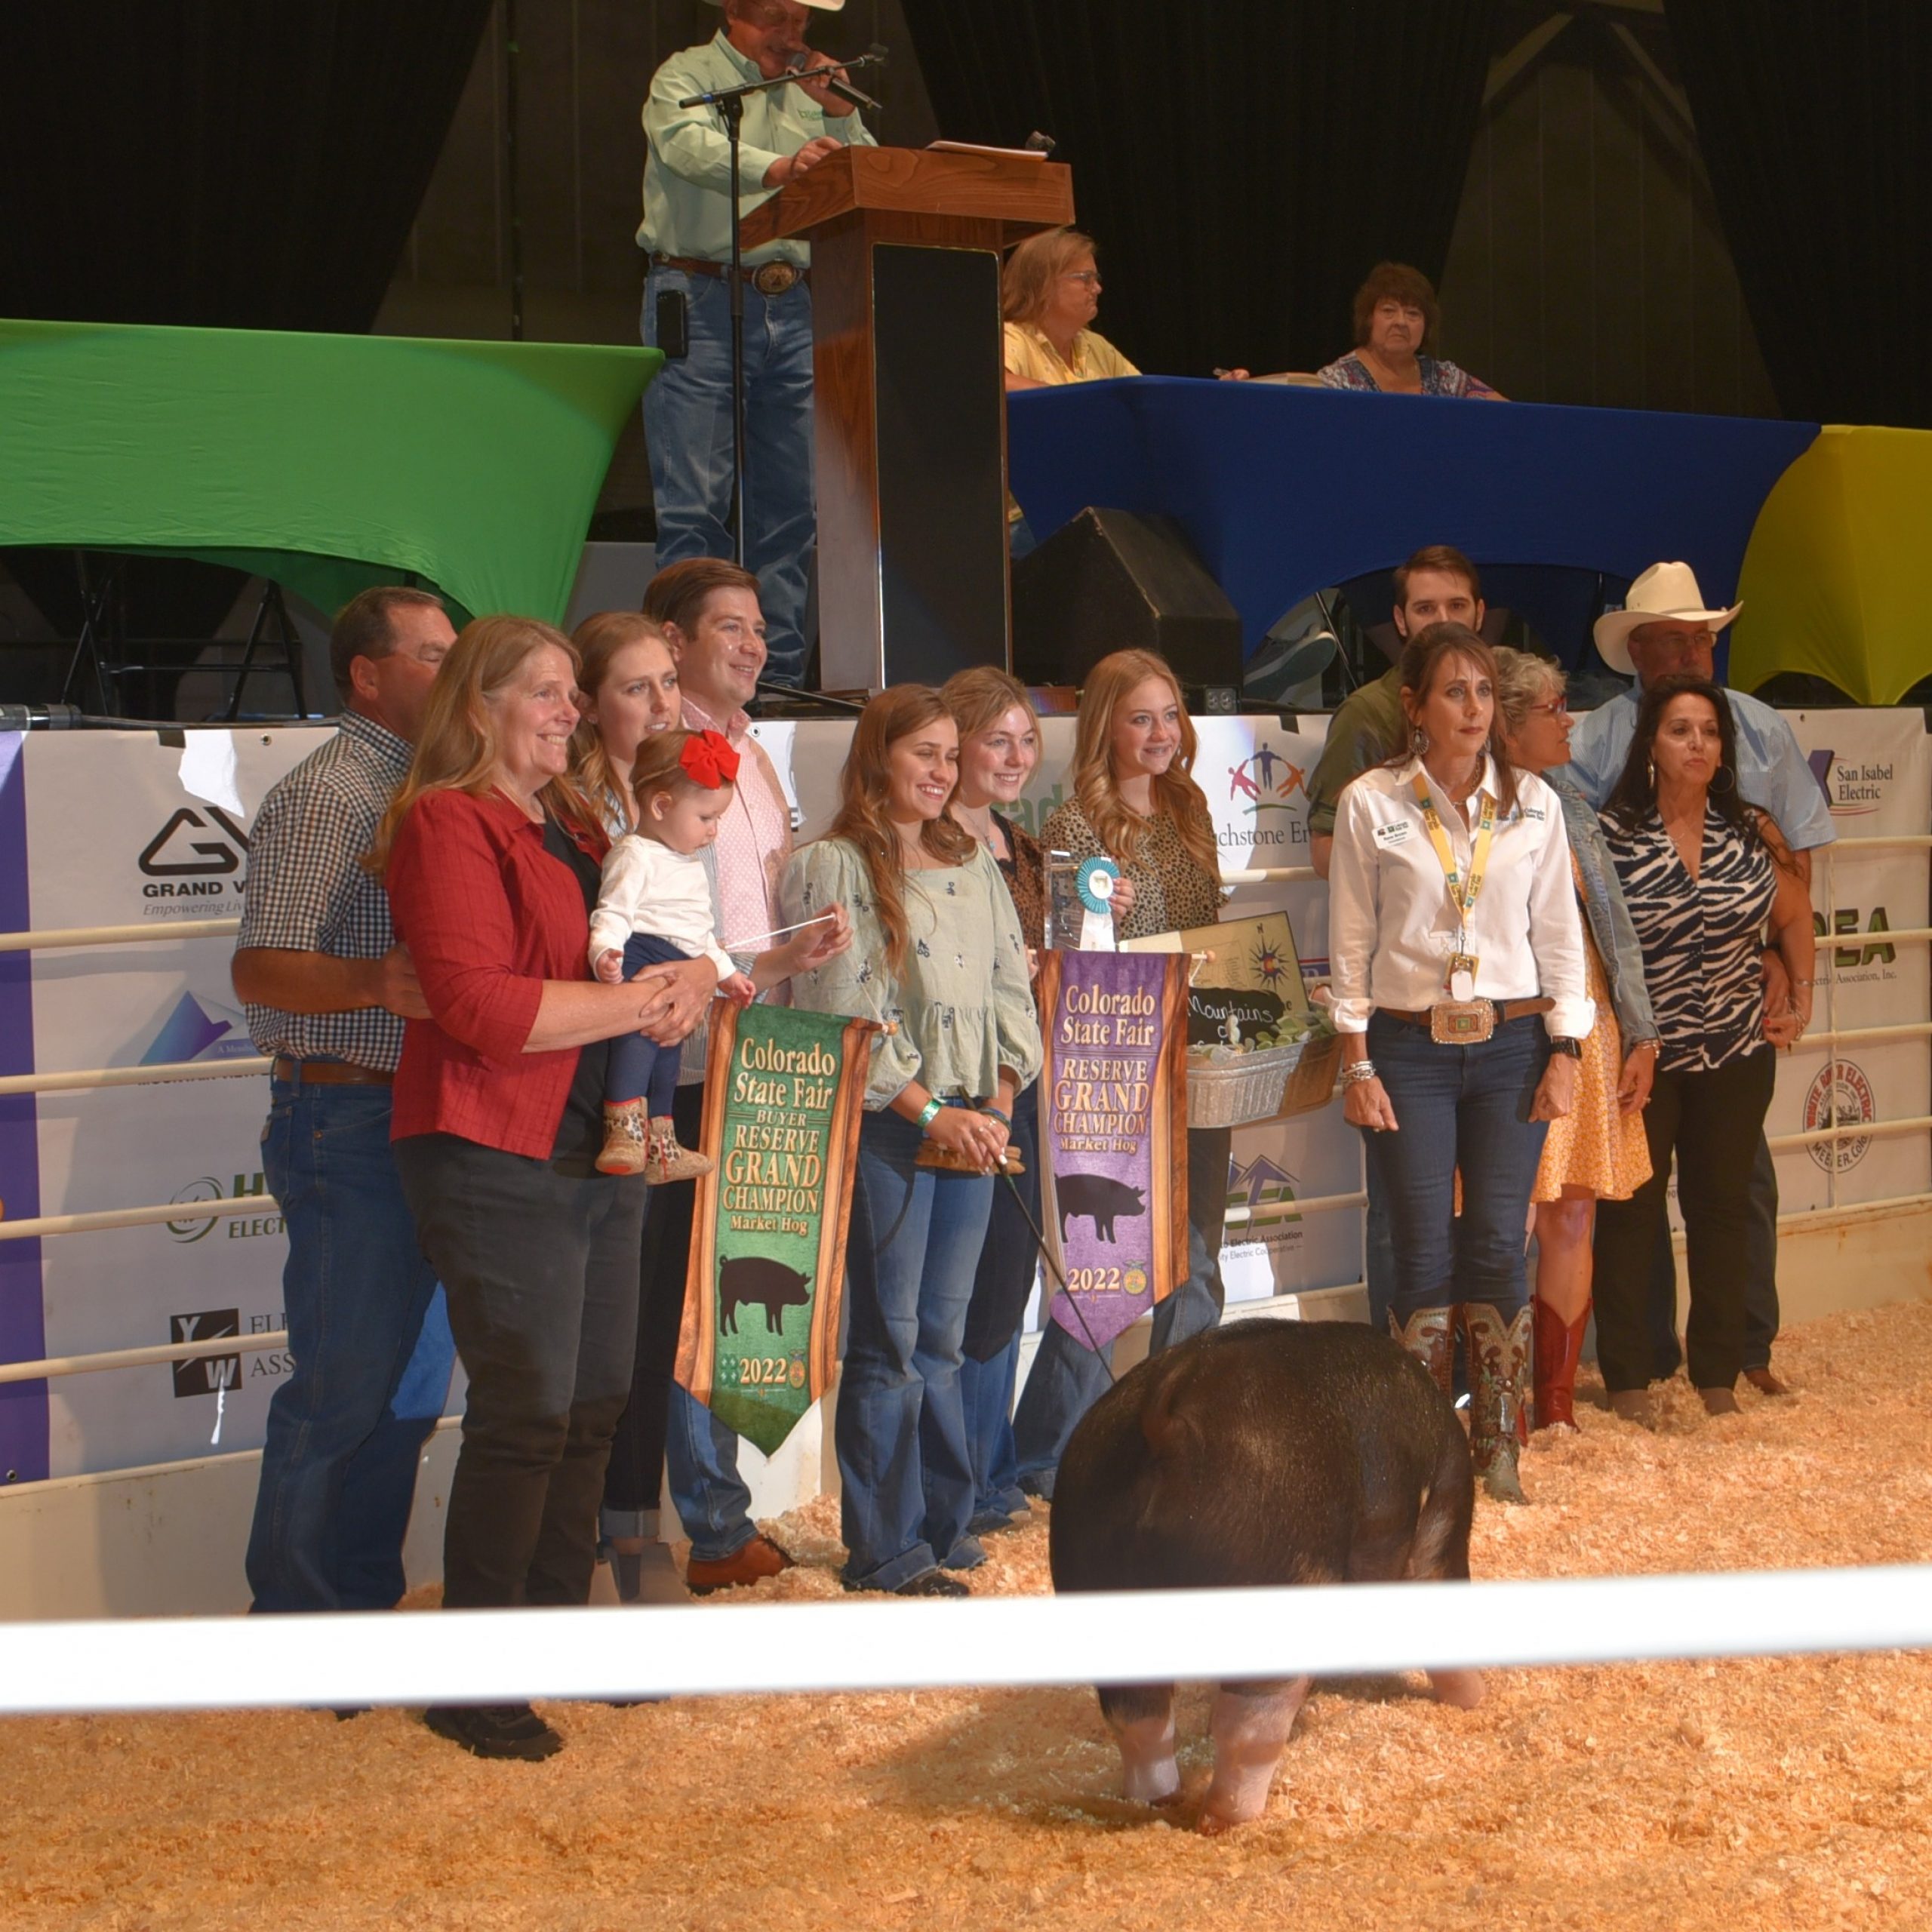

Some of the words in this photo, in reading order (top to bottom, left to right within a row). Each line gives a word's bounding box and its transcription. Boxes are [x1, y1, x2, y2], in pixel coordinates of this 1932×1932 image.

[1837, 765, 1858, 782] San
[1861, 764, 1893, 781] Isabel
[1839, 783, 1881, 801] Electric
[1216, 822, 1286, 846] chstone
[142, 881, 224, 898] GRAND
[143, 900, 224, 918] Empowering
[1066, 984, 1155, 1016] Colorado
[1060, 1016, 1111, 1045] State
[1114, 1017, 1155, 1046] Fair
[740, 1038, 836, 1076] Colorado
[1063, 1058, 1148, 1081] RESERVE
[734, 1072, 786, 1107] State
[792, 1078, 833, 1110] Fair
[1054, 1079, 1151, 1113] GRAND
[756, 1109, 807, 1127] BUYER
[1053, 1112, 1148, 1136] CHAMPION
[734, 1124, 820, 1152] RESERVE
[1059, 1137, 1108, 1152] Market
[1112, 1137, 1137, 1155] Hog
[1812, 1141, 1854, 1168] MEEER.
[724, 1149, 822, 1188] GRAND
[722, 1185, 820, 1214] CHAMPION
[229, 1217, 285, 1239] ELECT
[730, 1214, 777, 1232] Market
[780, 1217, 808, 1235] Hog
[1260, 1230, 1303, 1243] Association
[1229, 1249, 1254, 1260] Electric
[1066, 1267, 1121, 1291] 2022
[739, 1357, 787, 1385] 2022
